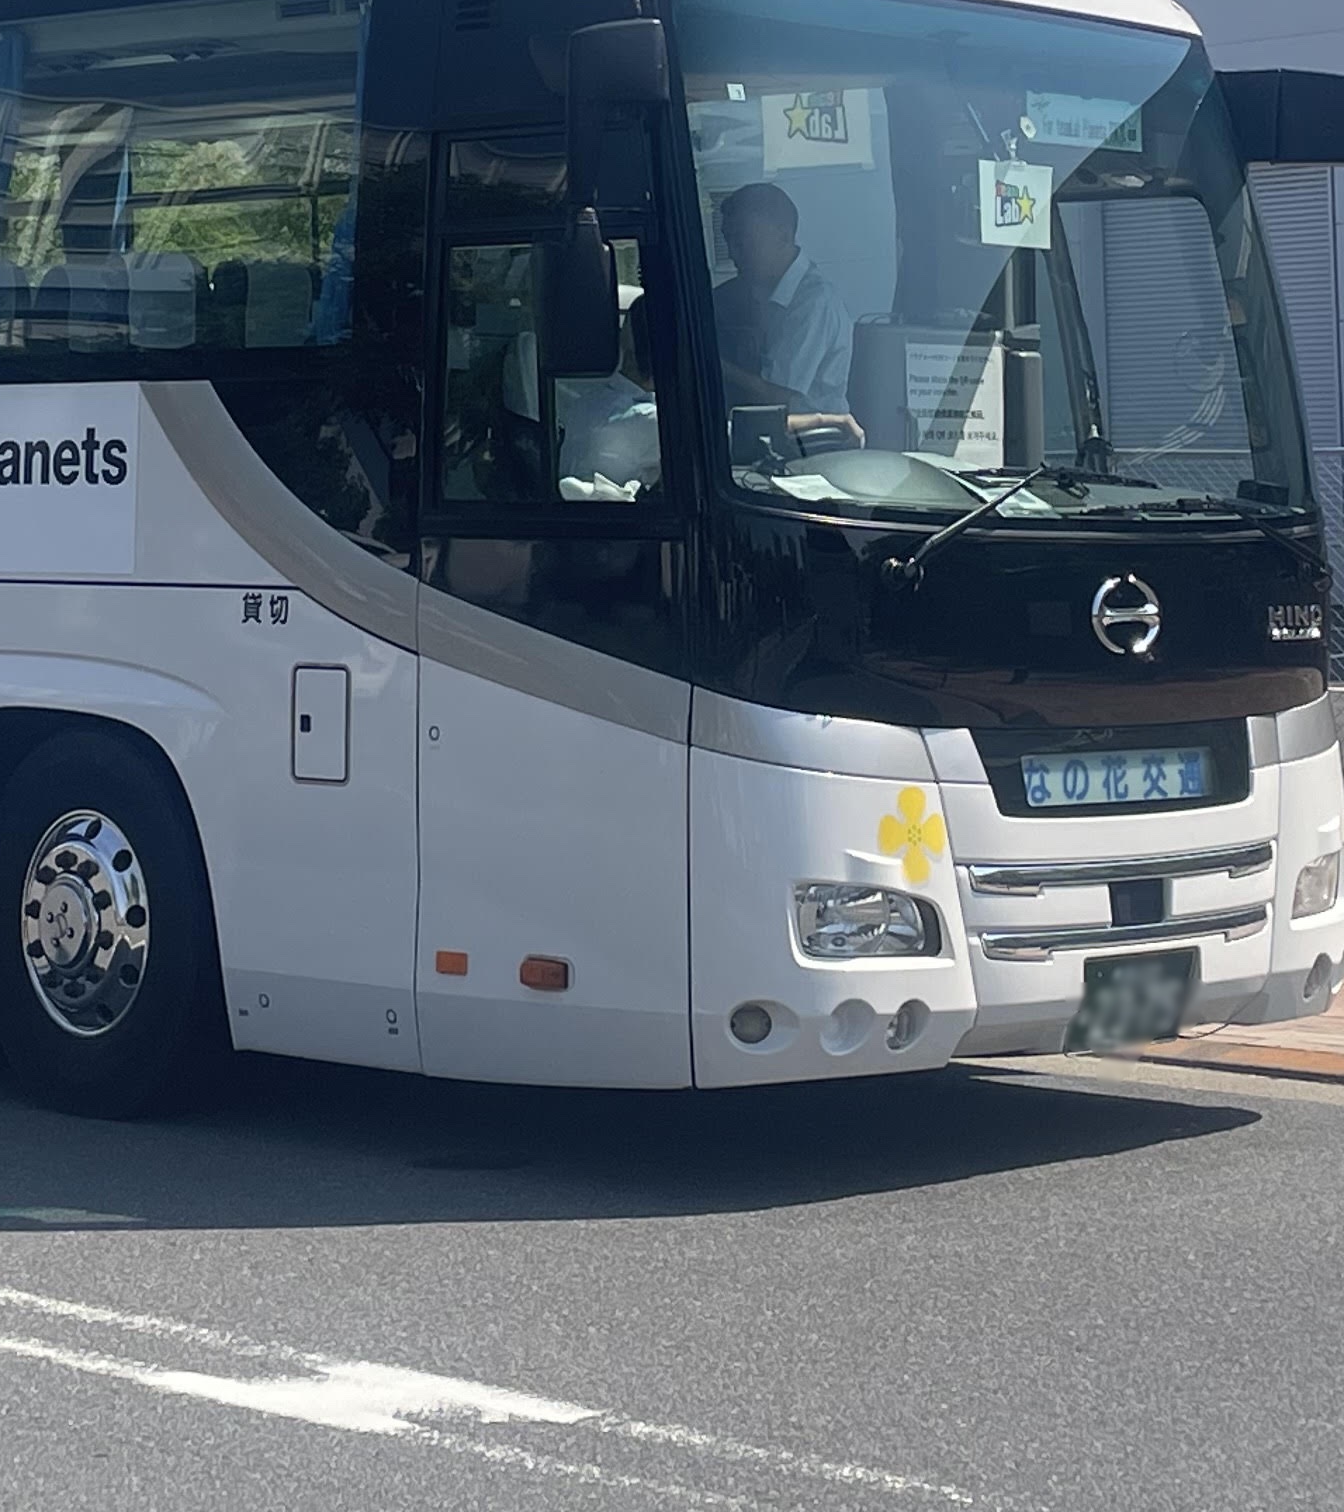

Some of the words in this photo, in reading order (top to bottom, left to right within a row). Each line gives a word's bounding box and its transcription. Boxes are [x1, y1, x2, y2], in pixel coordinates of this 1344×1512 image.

[996, 195, 1021, 225] Lab
[241, 592, 289, 625] 貸切
[1268, 604, 1322, 627] HINO
[1024, 750, 1205, 805] なの花交通
